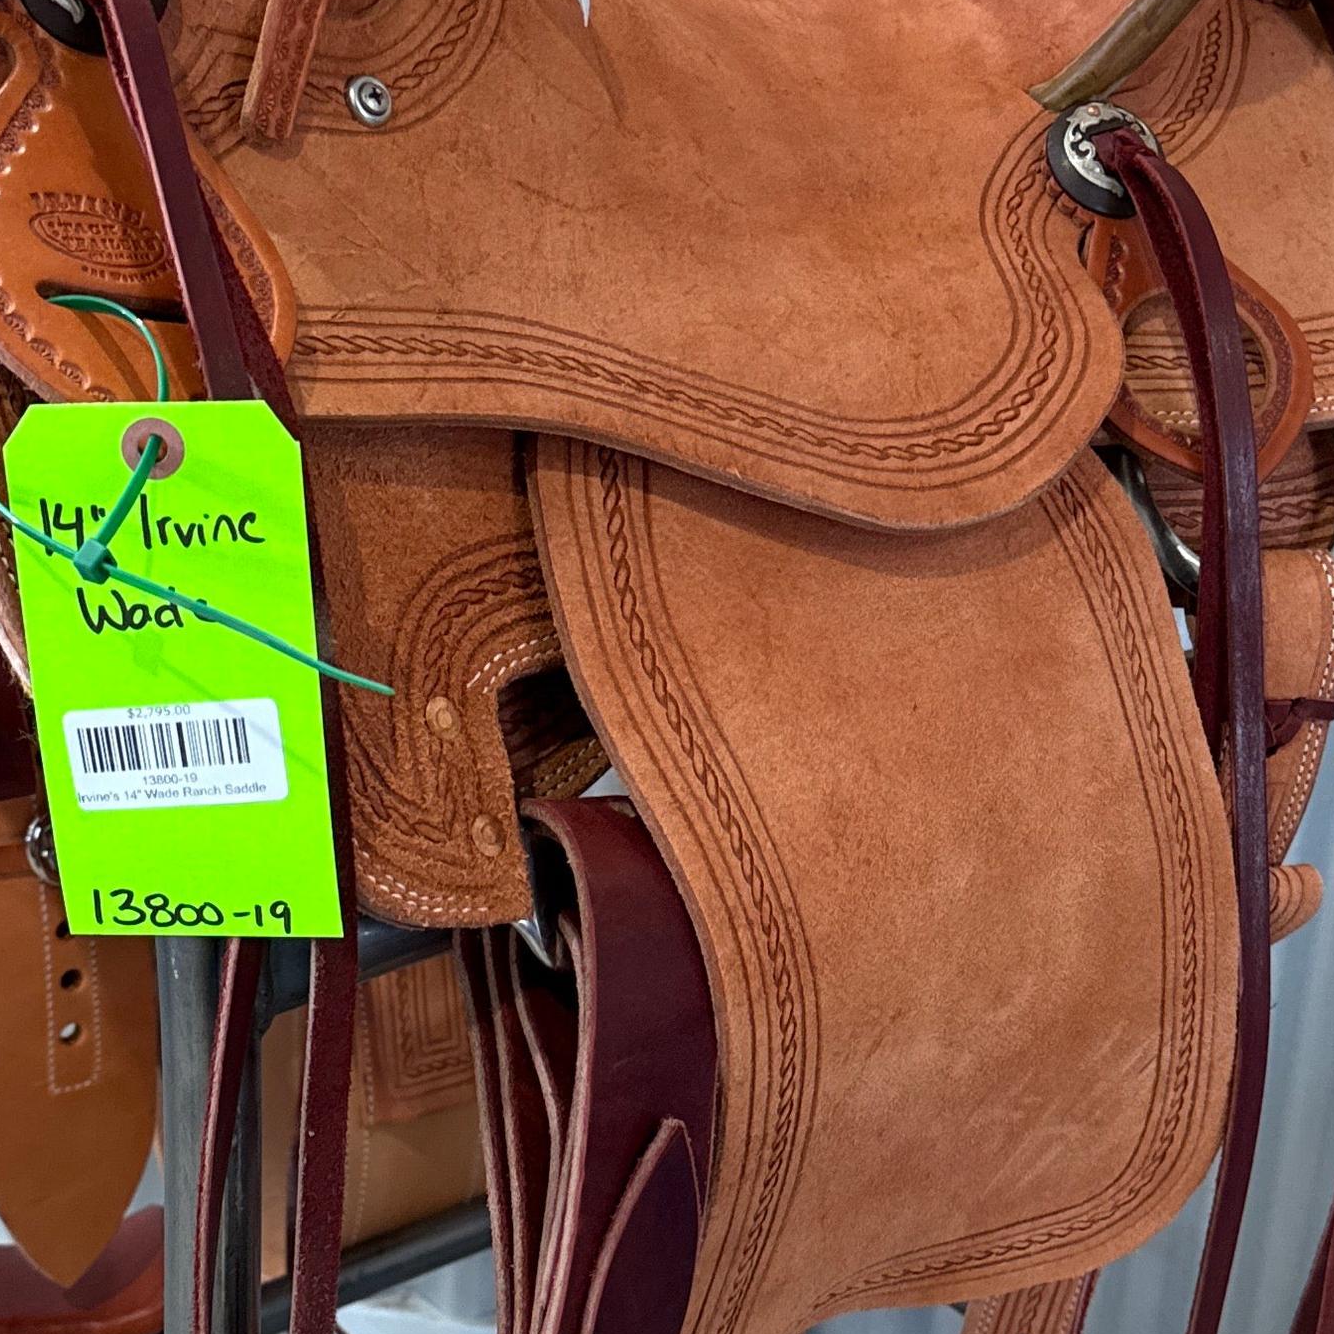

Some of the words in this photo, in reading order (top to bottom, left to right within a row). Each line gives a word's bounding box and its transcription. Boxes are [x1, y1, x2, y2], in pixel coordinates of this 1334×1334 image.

[139, 493, 266, 550] Irvine
[127, 704, 191, 719] $2,795.00
[142, 772, 199, 786] 13800-19
[77, 790, 121, 804] Irvine's
[124, 789, 143, 801] 14"
[145, 787, 180, 800] Wade
[182, 784, 224, 798] Ranch
[225, 781, 268, 796] Saddle
[92, 889, 292, 934] 13800-19
